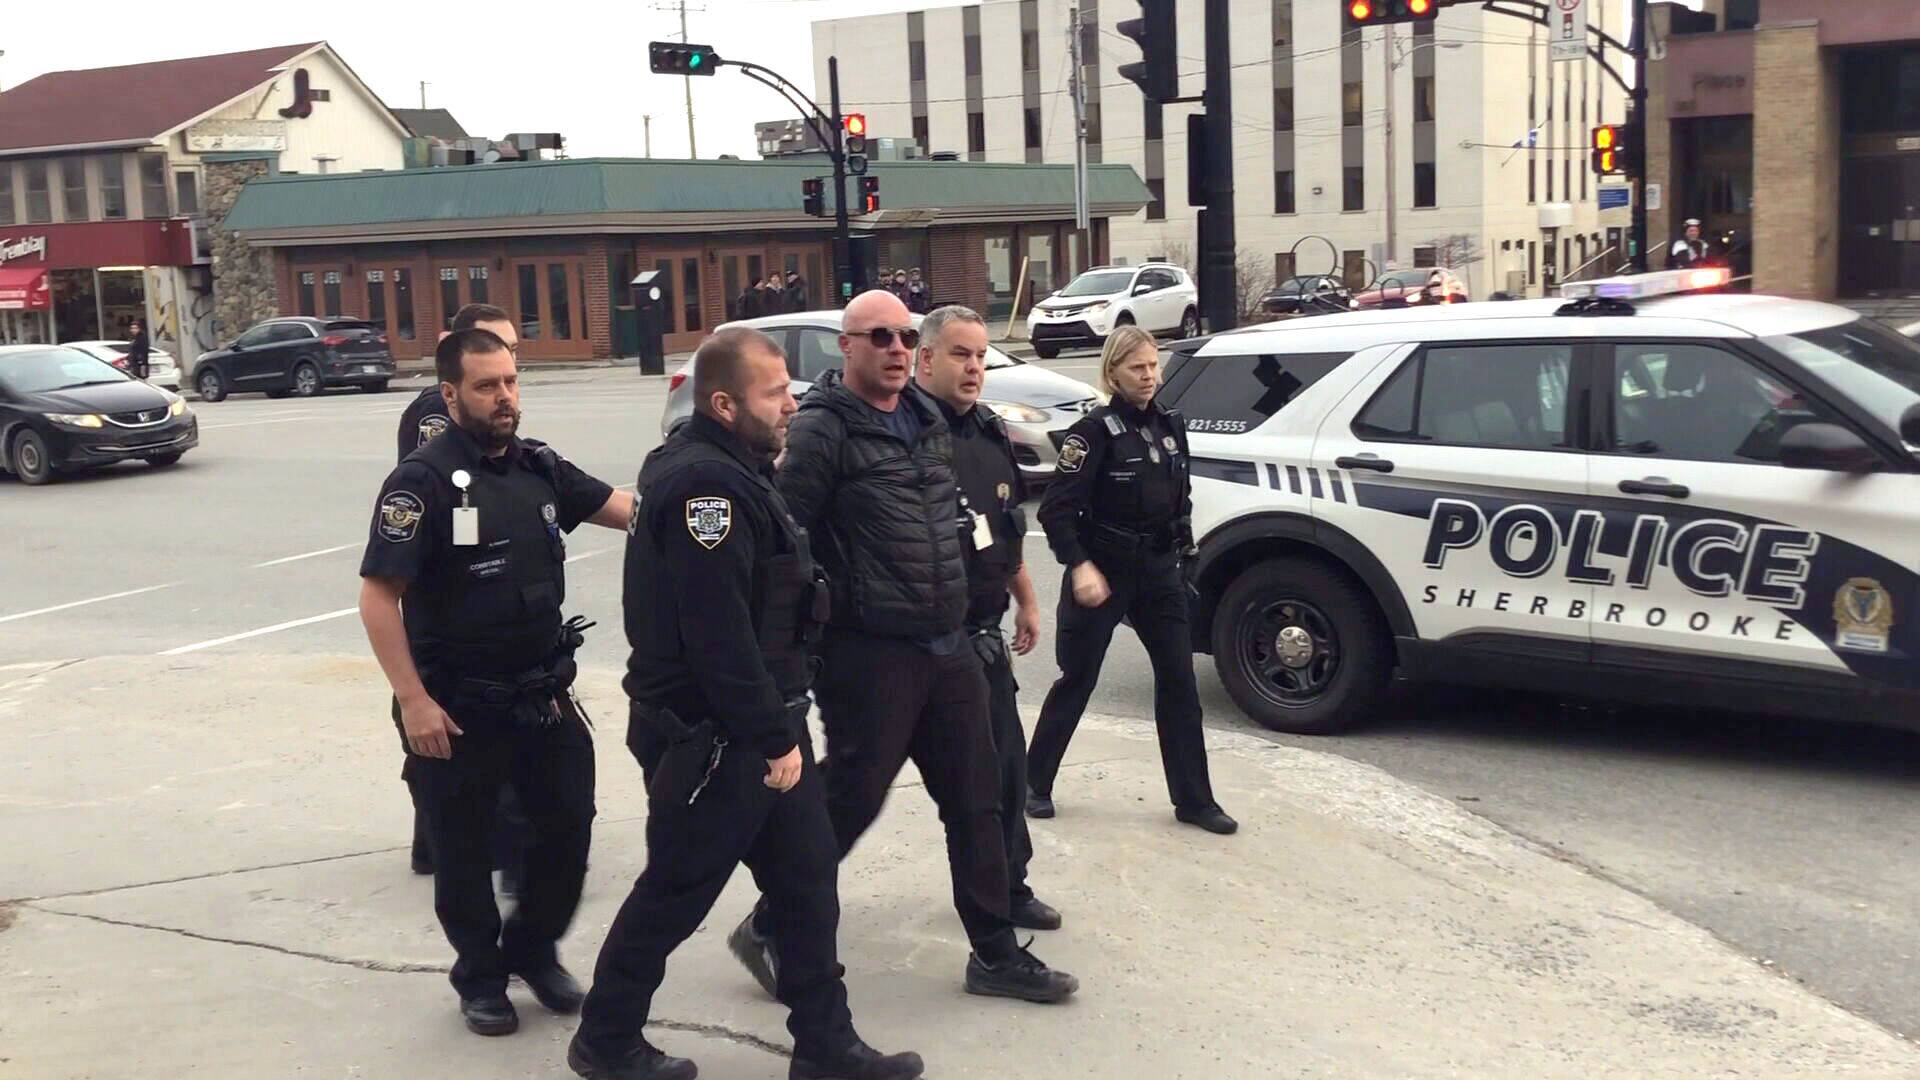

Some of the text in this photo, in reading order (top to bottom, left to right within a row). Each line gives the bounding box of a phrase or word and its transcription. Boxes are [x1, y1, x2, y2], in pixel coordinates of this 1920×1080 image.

[1188, 419, 1247, 432] 821-5555
[690, 501, 728, 510] POLICE
[1423, 498, 1821, 610] POLICE
[1422, 585, 1795, 640] SHERBROOKE
